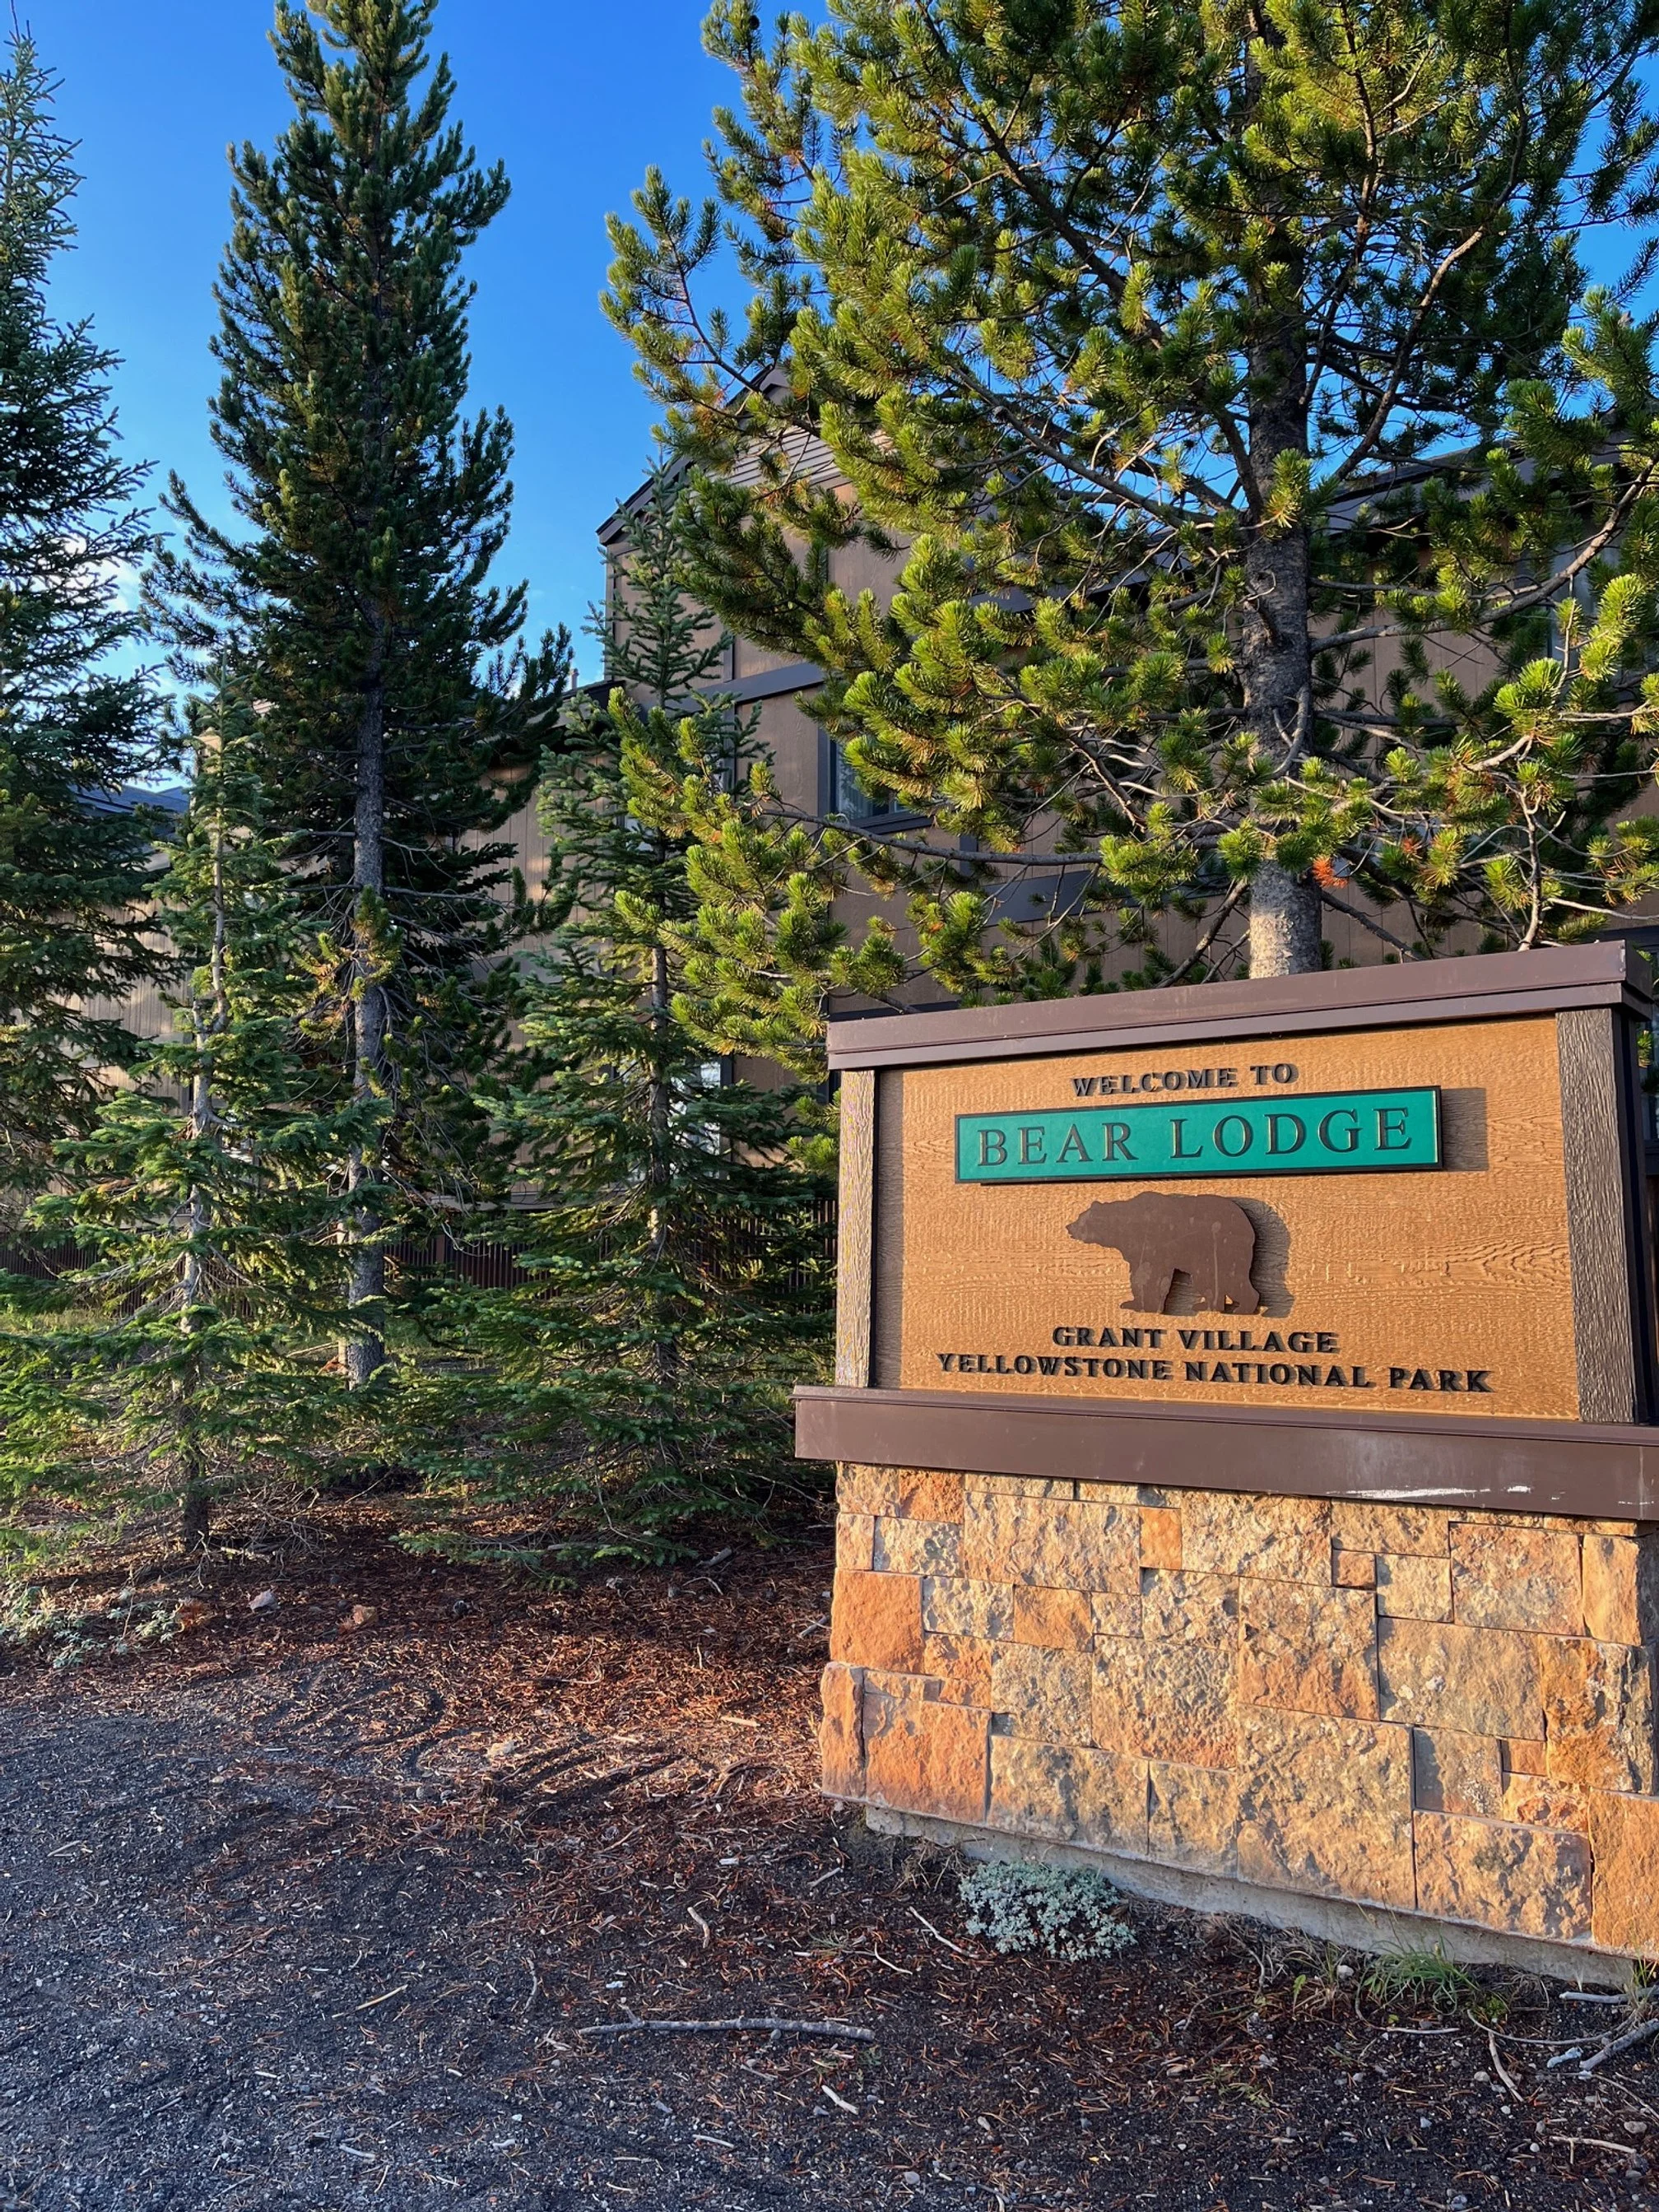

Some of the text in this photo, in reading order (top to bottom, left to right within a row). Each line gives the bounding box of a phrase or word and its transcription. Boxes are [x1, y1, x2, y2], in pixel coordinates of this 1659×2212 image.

[1072, 1063, 1298, 1097] WELCOME TO
[977, 1107, 1412, 1167] BEAR LODGE
[1053, 1326, 1338, 1354] GRANT VILLAGE
[938, 1353, 1493, 1392] YELLOWSTONE NATIONAL PARK
